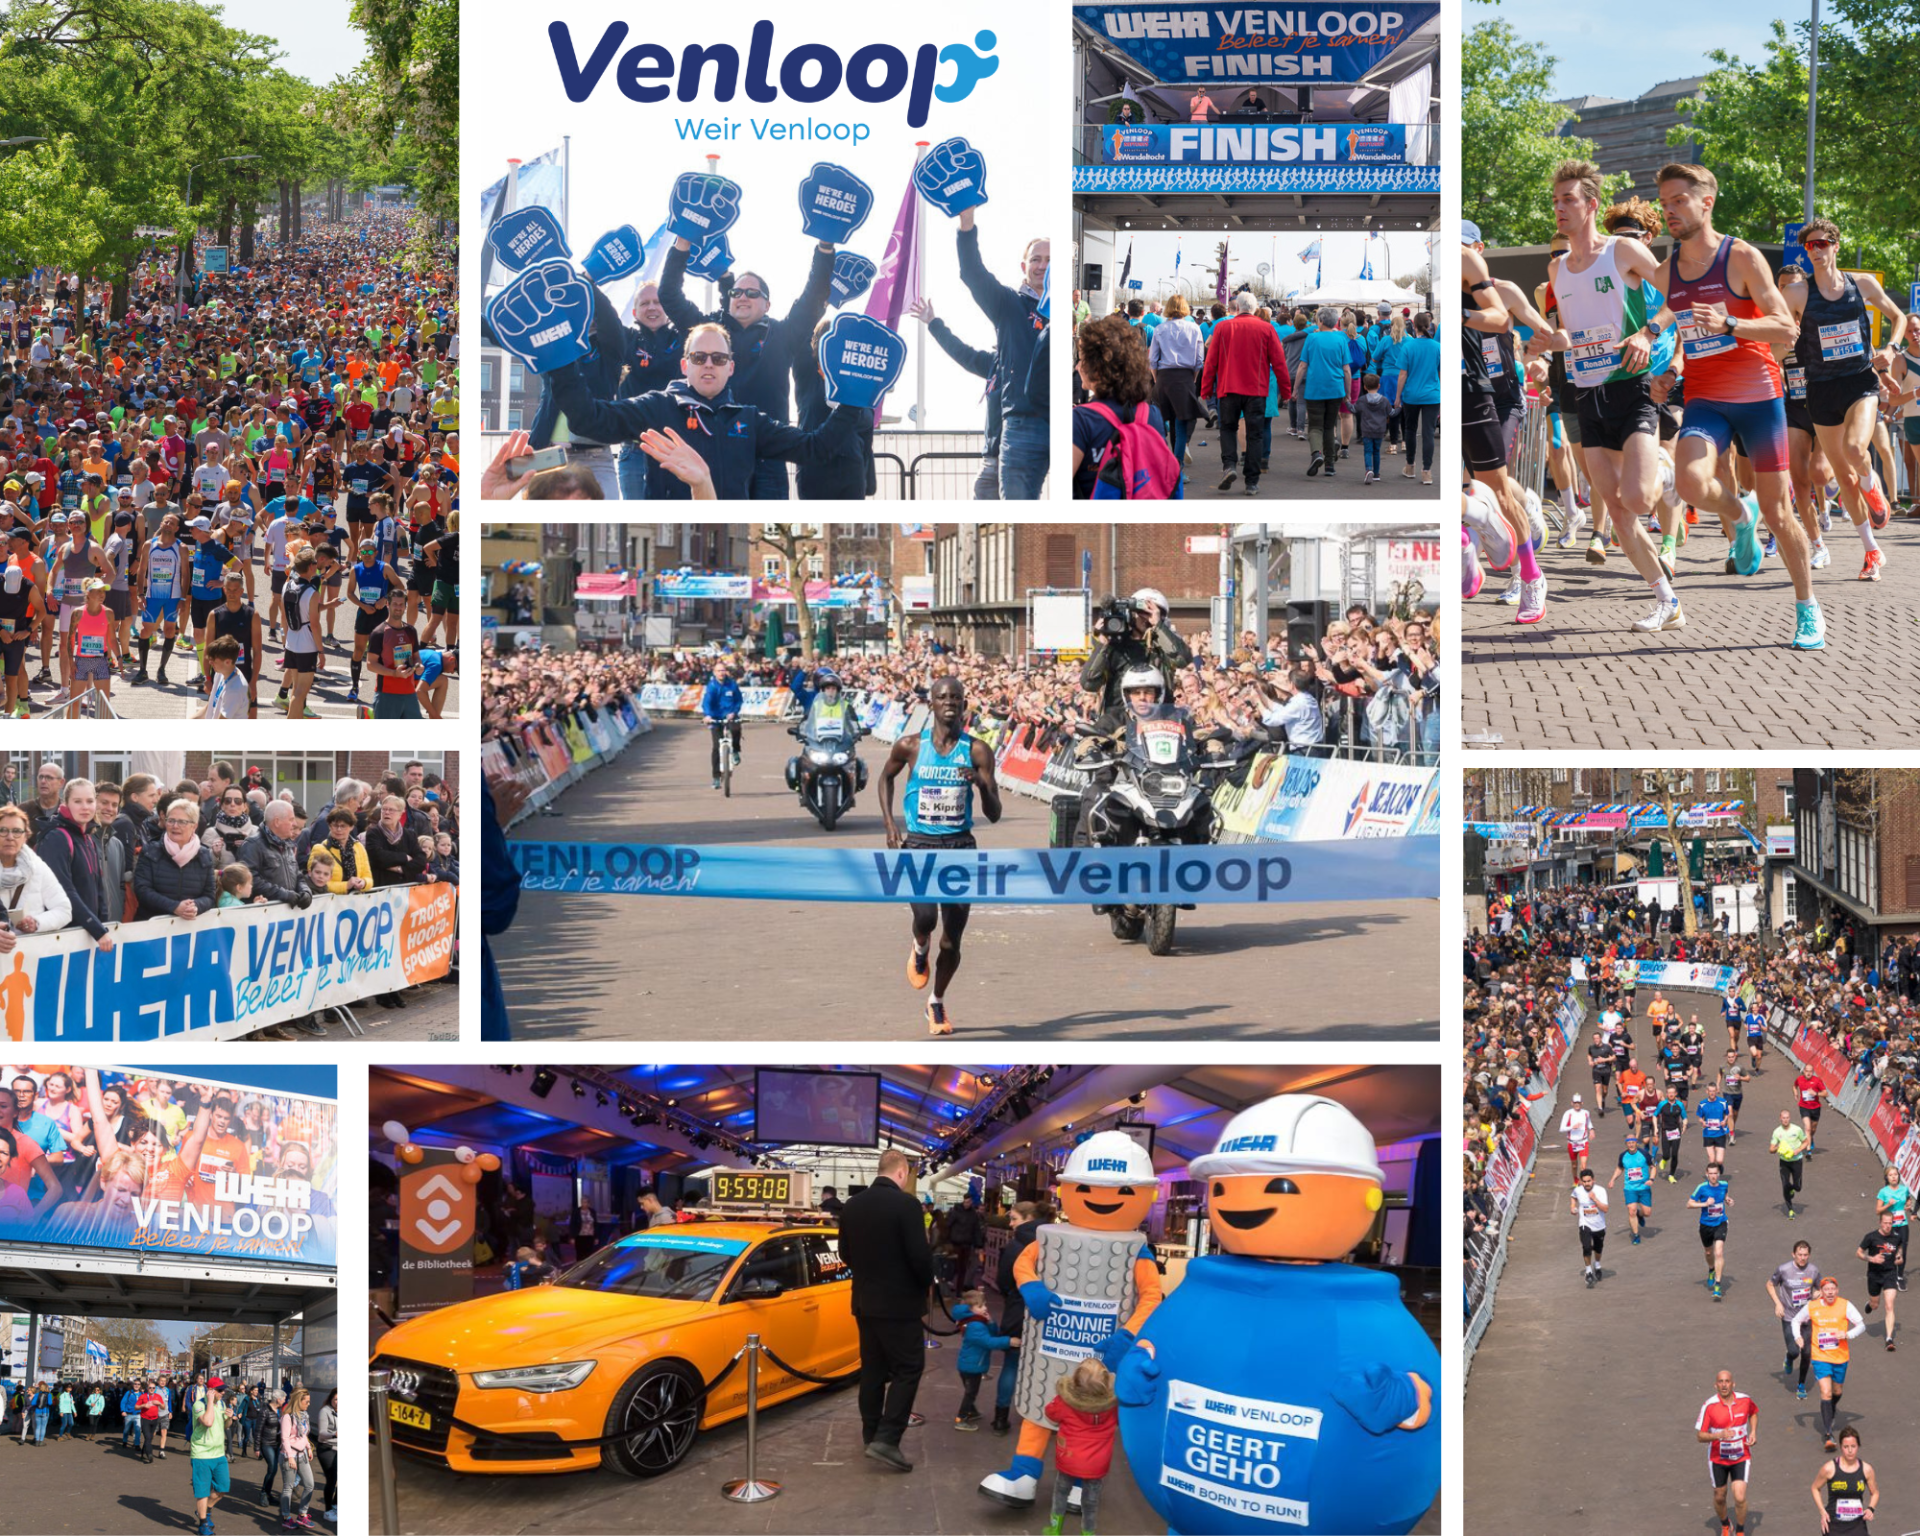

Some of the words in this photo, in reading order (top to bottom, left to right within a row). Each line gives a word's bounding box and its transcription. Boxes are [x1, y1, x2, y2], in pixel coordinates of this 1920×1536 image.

[1104, 11, 1210, 38] WEIR
[1215, 10, 1403, 37] VENLOOP
[1217, 31, 1299, 50] Beleef
[1295, 33, 1321, 54] je
[1327, 29, 1404, 47] samen!
[1184, 54, 1332, 76] FINISH
[1121, 127, 1153, 135] VENLOOP
[1356, 127, 1389, 135] VENLOOP
[1170, 128, 1337, 161] FINISH
[815, 193, 857, 214] HEROES
[818, 185, 843, 199] WE'RE
[843, 190, 857, 203] ALL
[507, 229, 527, 249] WE'RE
[525, 220, 539, 234] ALL
[514, 226, 547, 259] HEROES
[529, 320, 573, 348] WEIR
[1597, 333, 1612, 341] 2022
[1834, 336, 1850, 345] Levi
[844, 340, 872, 354] WE'RE
[873, 345, 889, 357] ALL
[1585, 343, 1605, 358] 115
[1694, 340, 1722, 352] Daan
[1833, 345, 1854, 357] M151
[841, 351, 888, 371] HEROES
[1583, 356, 1613, 370] Ronald
[920, 802, 930, 811] S.
[580, 867, 605, 893] je
[612, 867, 702, 892] samen!
[874, 851, 1017, 898] Weir
[1047, 848, 1293, 901] Venloop
[409, 892, 452, 929] TROTSE
[406, 919, 451, 951] HOOFD-
[33, 926, 237, 1041] WEIR
[247, 901, 394, 983] VENLOOP
[235, 957, 312, 1023] Beleef
[308, 951, 333, 1010] je
[1088, 1158, 1128, 1173] WEIR
[214, 1171, 311, 1210] WEIR
[718, 1178, 788, 1199] 9:59:08
[132, 1196, 313, 1241] VENLOOP
[129, 1226, 209, 1249] Beleef
[205, 1232, 233, 1255] je
[402, 1261, 415, 1269] de
[417, 1259, 473, 1269] Bibliotheek
[1083, 1301, 1117, 1310] VENLOOP
[1046, 1310, 1113, 1333] RONNIE
[1059, 1348, 1080, 1358] BORN
[1205, 1399, 1237, 1416] WEIR
[1241, 1406, 1314, 1427] VENLOOP
[1187, 1424, 1286, 1462] GEERT
[1185, 1446, 1281, 1489] GEHO
[1167, 1475, 1195, 1494] WEIR
[1199, 1487, 1237, 1508] BORN
[1241, 1499, 1261, 1512] TO
[1265, 1504, 1302, 1519] RUN!
